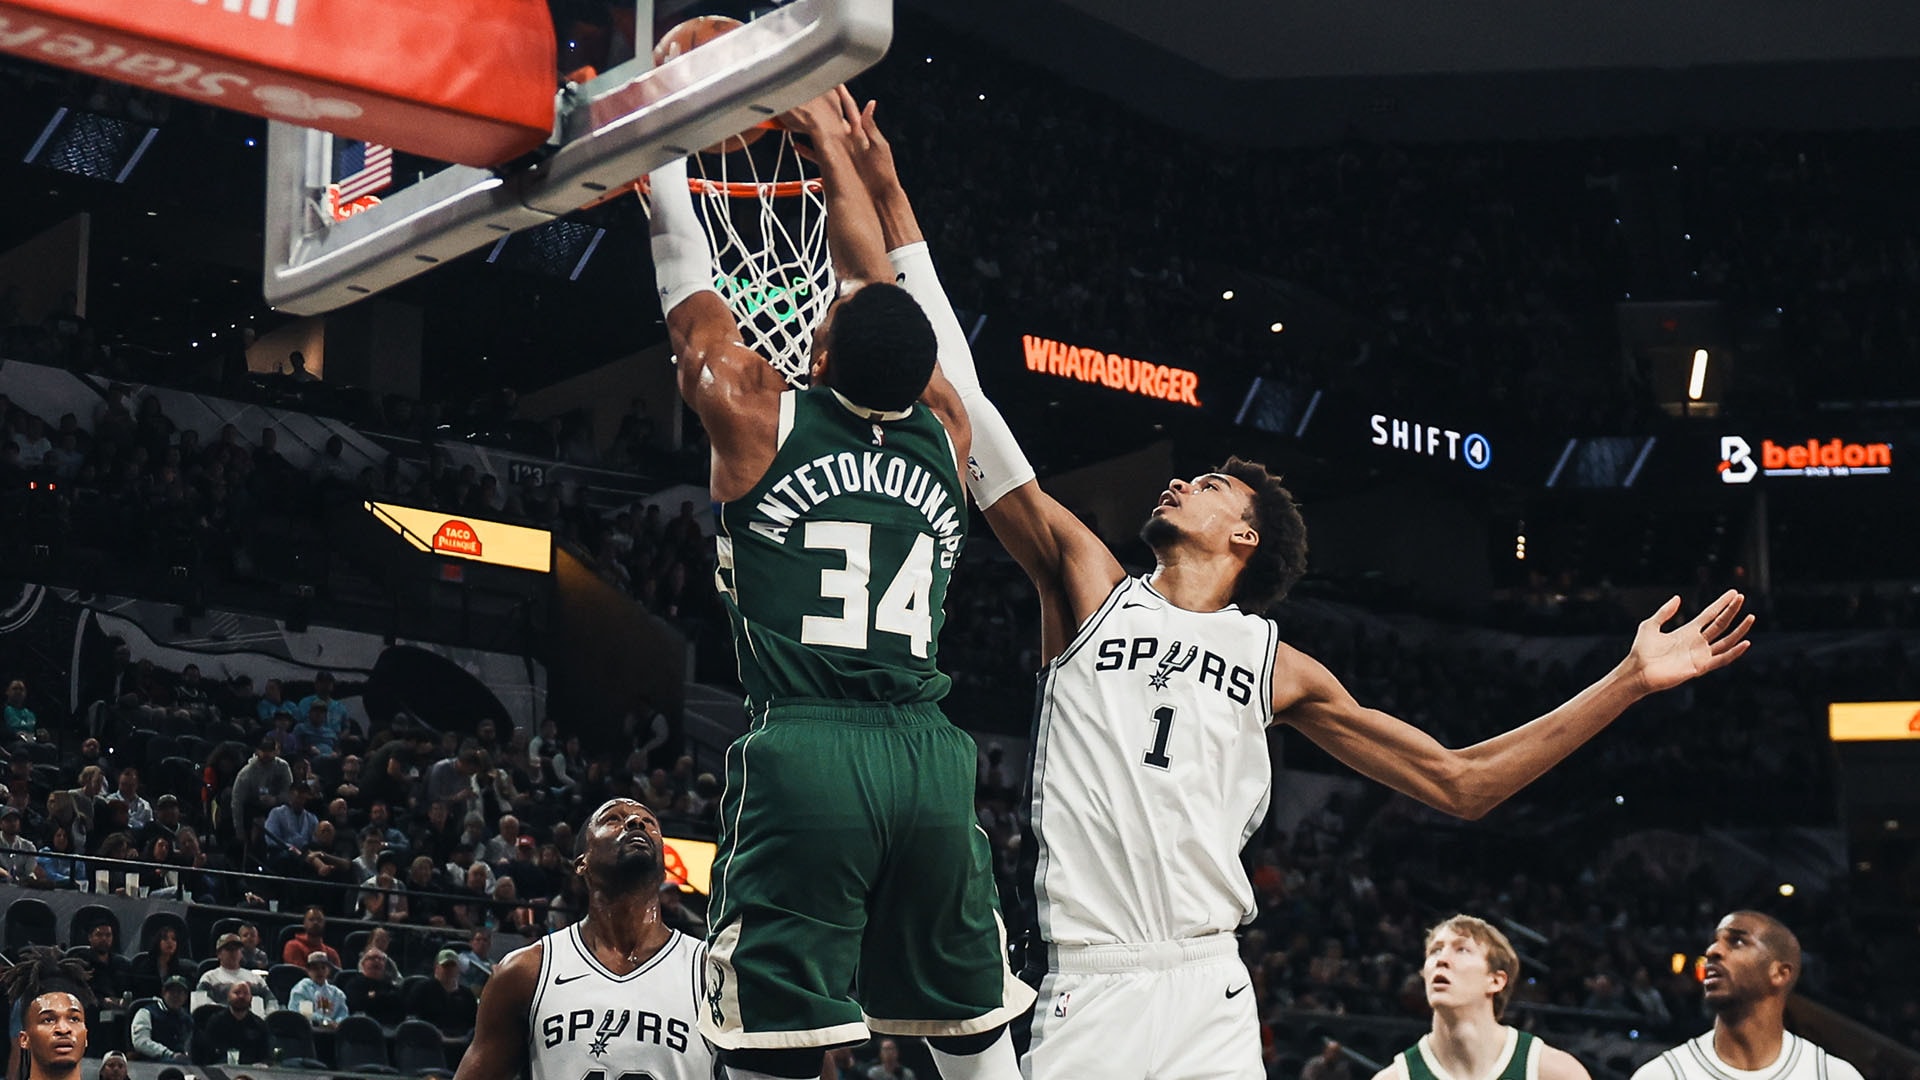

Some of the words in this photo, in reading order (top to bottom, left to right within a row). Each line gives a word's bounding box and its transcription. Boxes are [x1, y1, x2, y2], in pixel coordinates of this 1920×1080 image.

[1022, 334, 1201, 407] WHATABURGER
[1762, 438, 1891, 468] beldon
[445, 527, 471, 540] TACO
[801, 521, 935, 659] 34
[1096, 637, 1255, 707] SPURS
[1140, 703, 1178, 773] 1
[543, 1009, 690, 1058] SPURS
